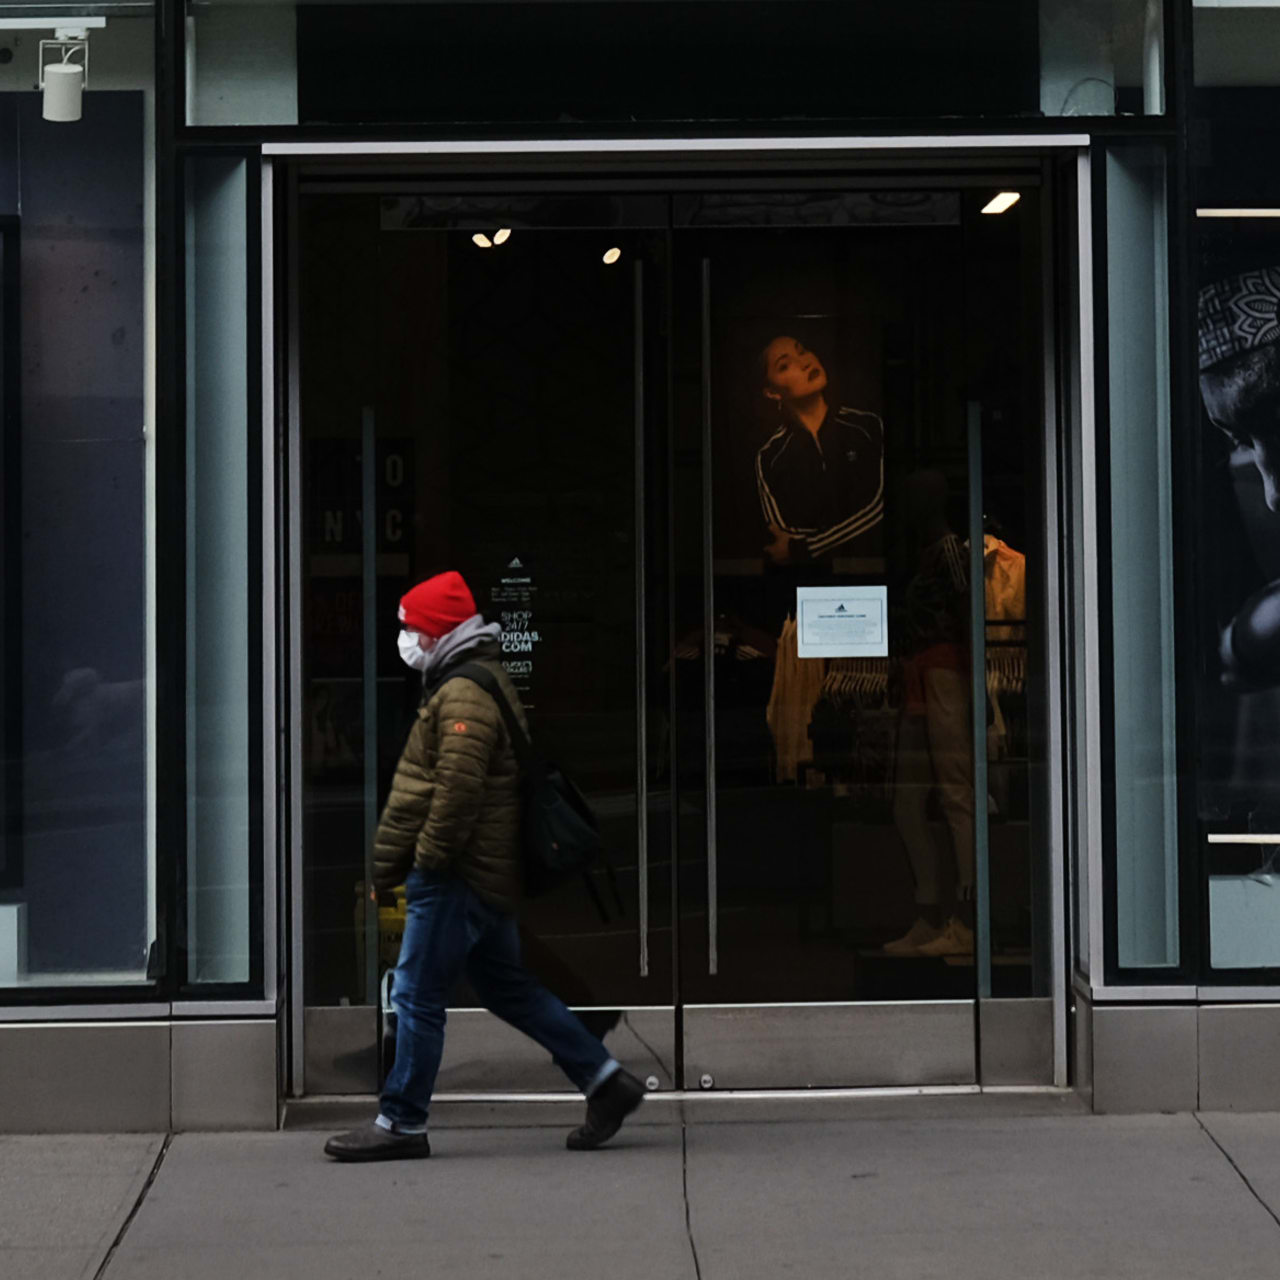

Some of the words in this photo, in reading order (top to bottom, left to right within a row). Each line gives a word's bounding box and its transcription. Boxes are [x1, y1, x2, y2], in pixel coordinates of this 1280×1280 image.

[501, 611, 533, 622] SHOP
[505, 621, 529, 631] 24/7
[497, 631, 542, 642] DIDAS.
[502, 642, 532, 653] COM
